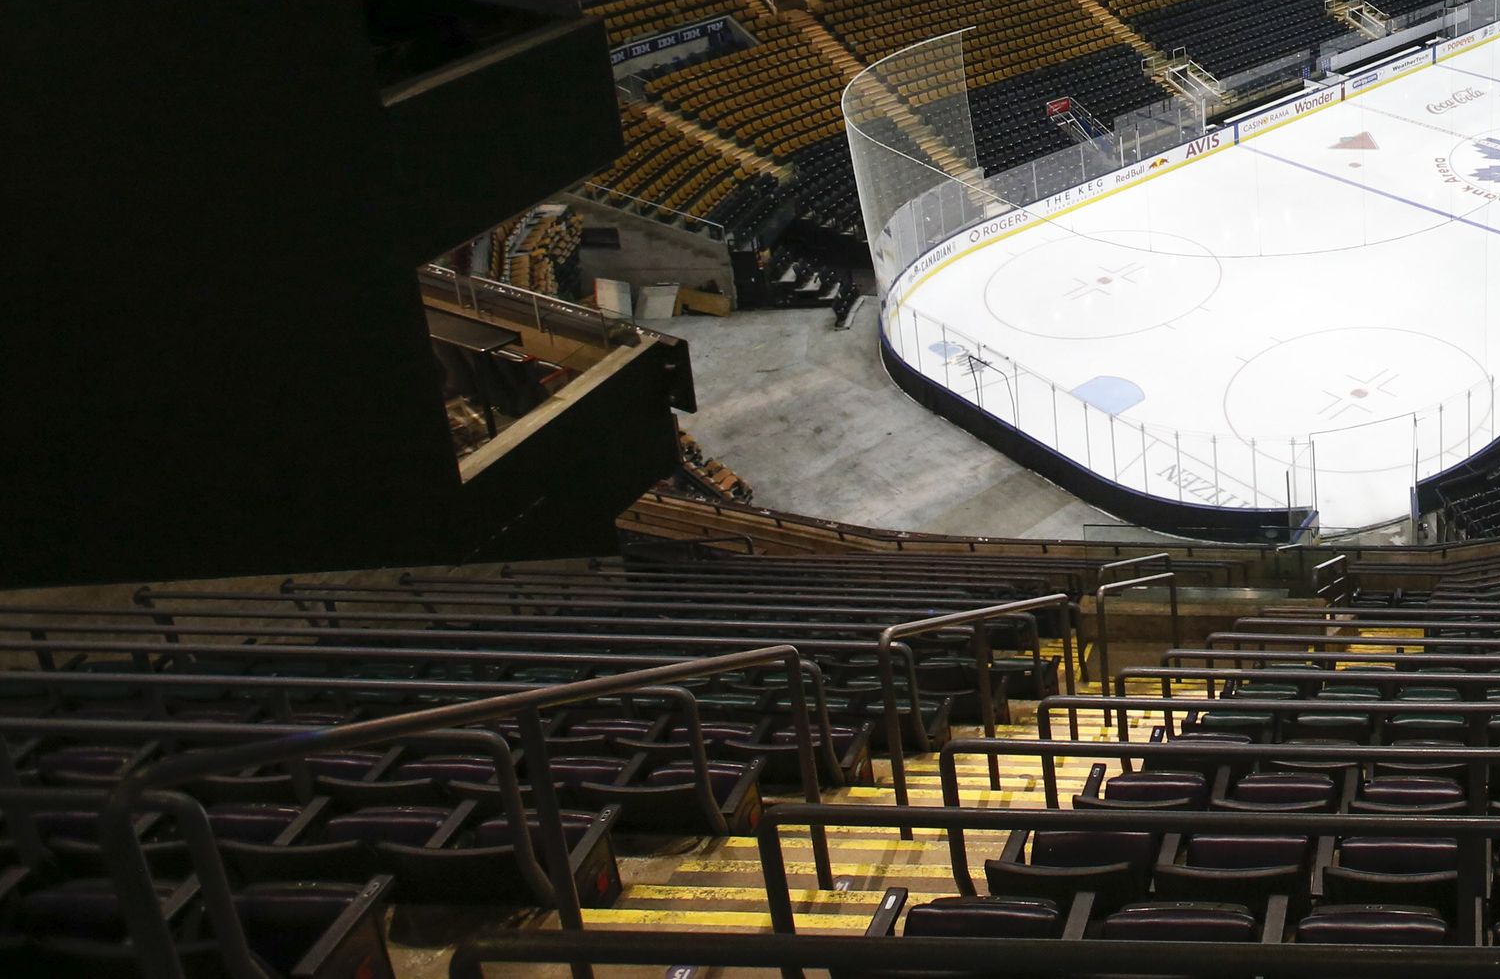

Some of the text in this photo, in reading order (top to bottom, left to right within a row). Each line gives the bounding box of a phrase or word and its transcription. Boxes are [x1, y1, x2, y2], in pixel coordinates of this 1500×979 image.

[631, 42, 652, 57] IBM
[657, 35, 677, 49] IBM
[682, 28, 702, 41] IBM
[1392, 54, 1430, 72] WeatherTech
[1269, 108, 1290, 123] RAMA
[1294, 91, 1335, 115] Wonder
[1185, 133, 1221, 159] AVIS
[1434, 157, 1461, 185] Arena
[1045, 191, 1071, 208] THE
[1078, 178, 1104, 195] KEG
[983, 210, 1029, 237] ROGERS
[921, 242, 953, 272] CANADIAN
